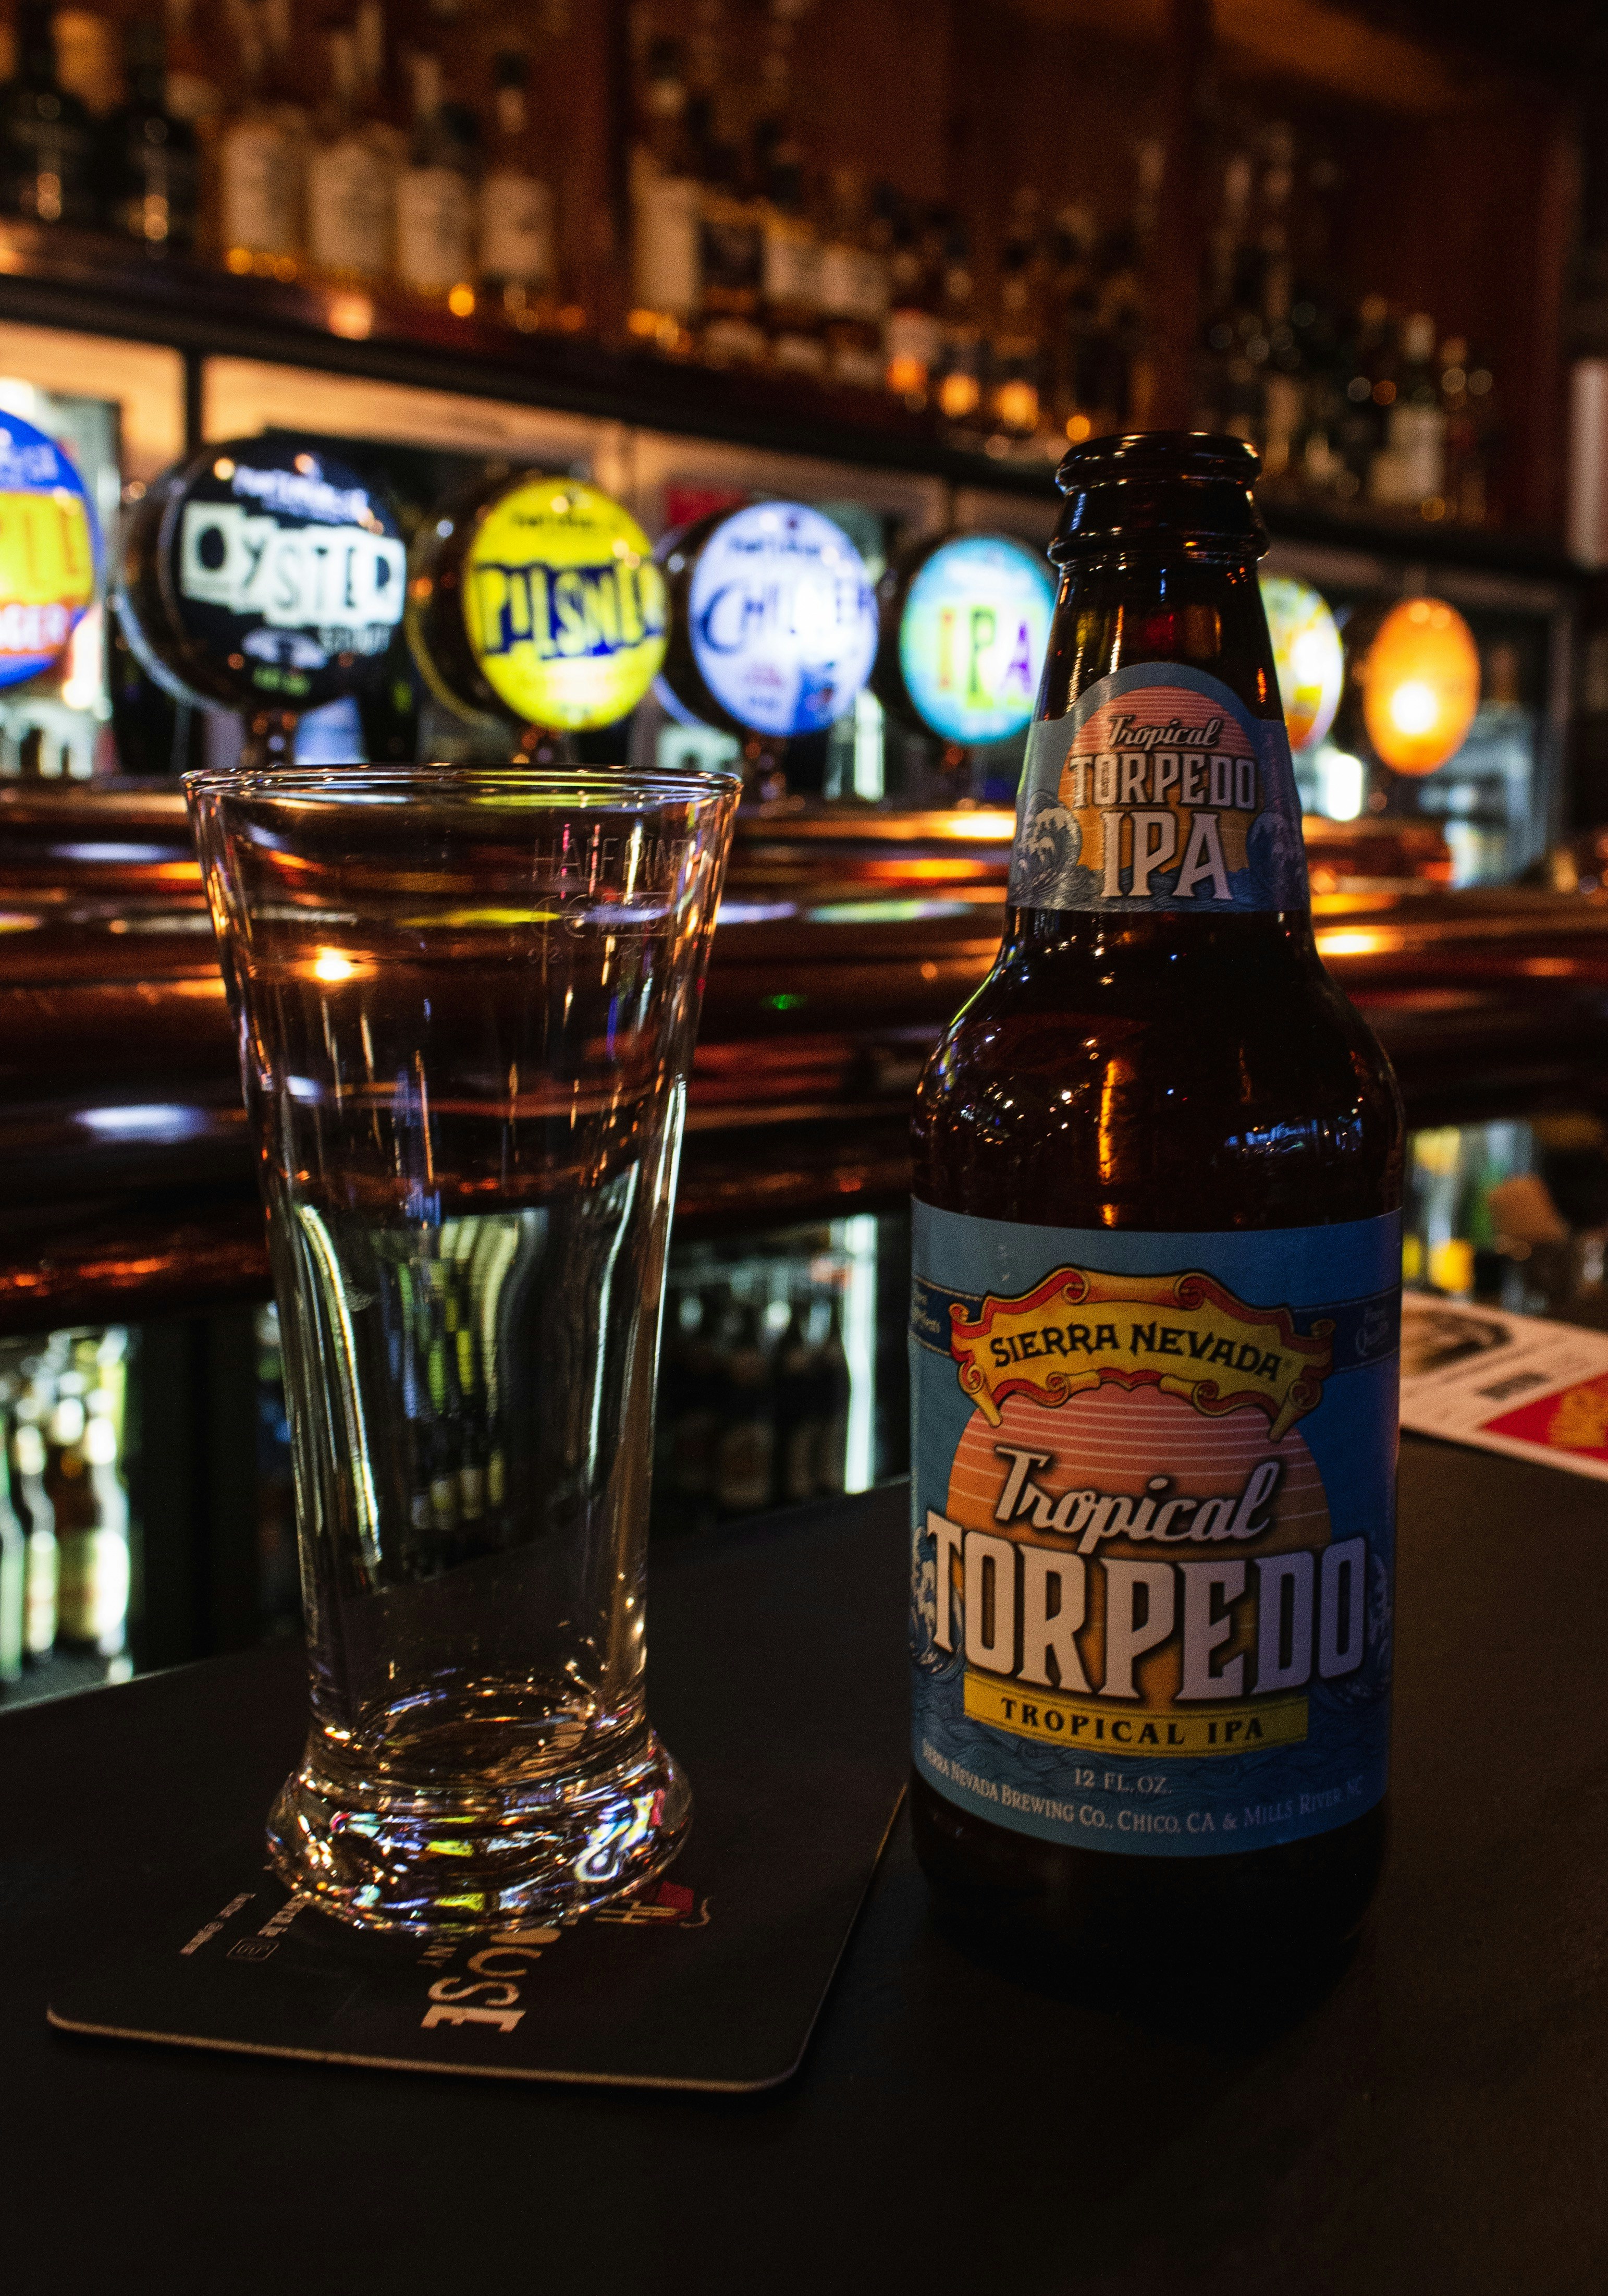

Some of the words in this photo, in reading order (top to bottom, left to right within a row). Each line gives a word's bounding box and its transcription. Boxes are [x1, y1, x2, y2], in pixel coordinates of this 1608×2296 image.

[937, 605, 1034, 703] IPA
[1108, 714, 1223, 752] Tropical
[1069, 753, 1256, 810] TORPEDO
[1100, 811, 1233, 900] IPA
[989, 1323, 1119, 1368] SIERRA
[1130, 1321, 1283, 1382] NEVADA
[993, 1445, 1281, 1555] Tropical
[927, 1510, 1366, 1702] TORPEDO
[1001, 1697, 1185, 1745] TROPICAL
[1207, 1721, 1265, 1744] IPA
[950, 1760, 999, 1802] NEVADA
[1001, 1783, 1076, 1823] BREWING
[1186, 1812, 1216, 1834] CA
[1222, 1812, 1238, 1830] &
[1243, 1799, 1293, 1828] MILLS
[1074, 1766, 1096, 1788] 12
